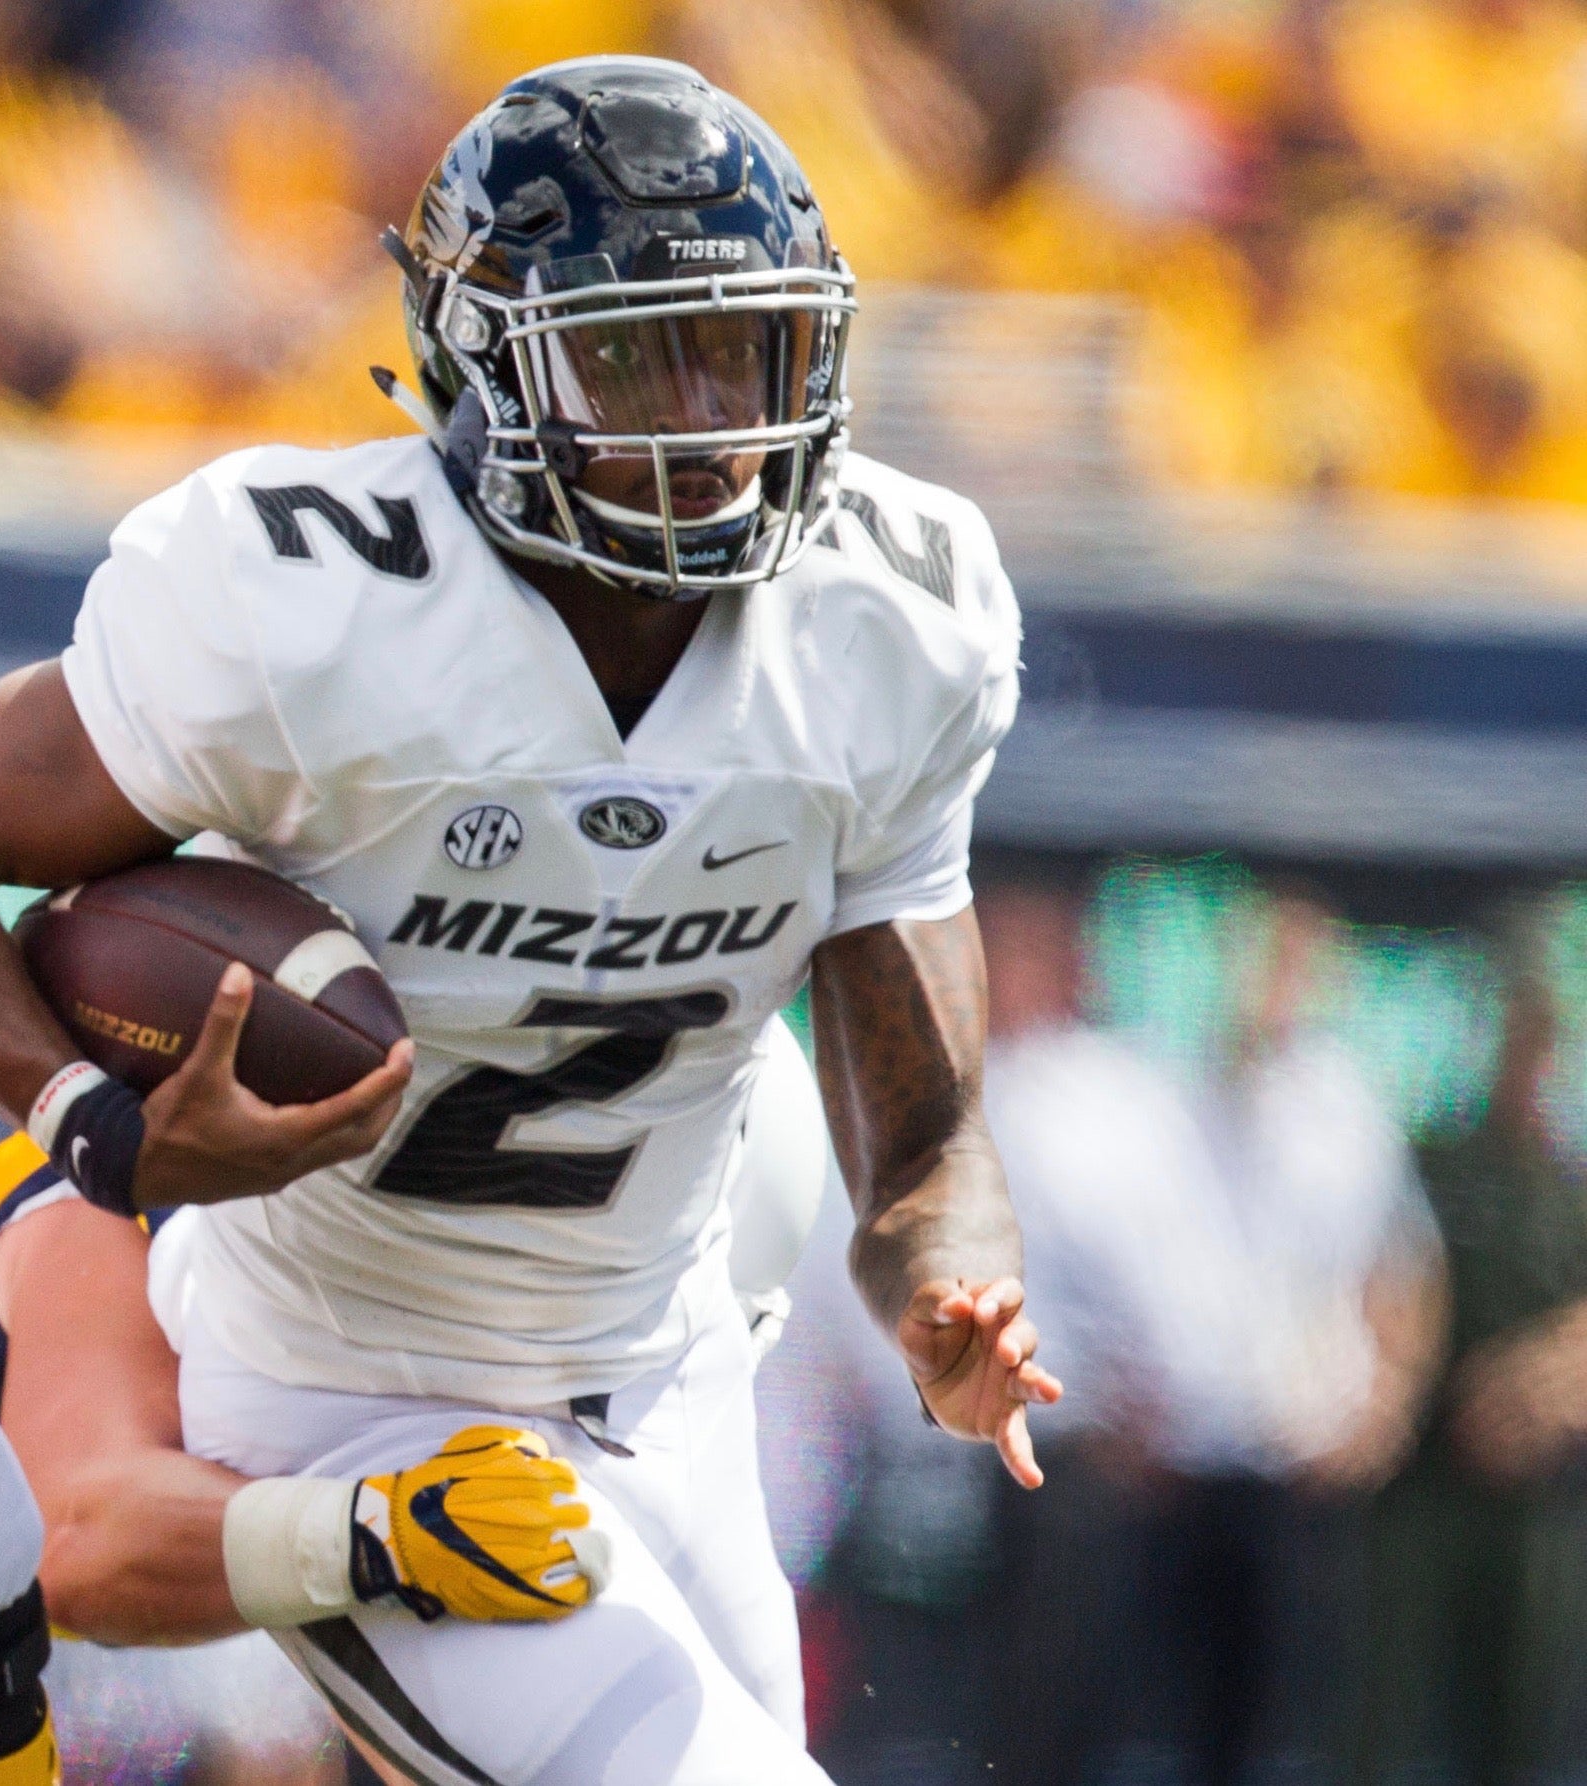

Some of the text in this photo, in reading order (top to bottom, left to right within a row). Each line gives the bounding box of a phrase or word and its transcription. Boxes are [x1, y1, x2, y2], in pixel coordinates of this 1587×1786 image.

[668, 239, 746, 260] TIGERS
[244, 483, 438, 584] 2
[814, 487, 958, 613] 2
[446, 806, 522, 870] SEC
[386, 893, 800, 970] MIZZOU
[365, 980, 739, 1218] 2
